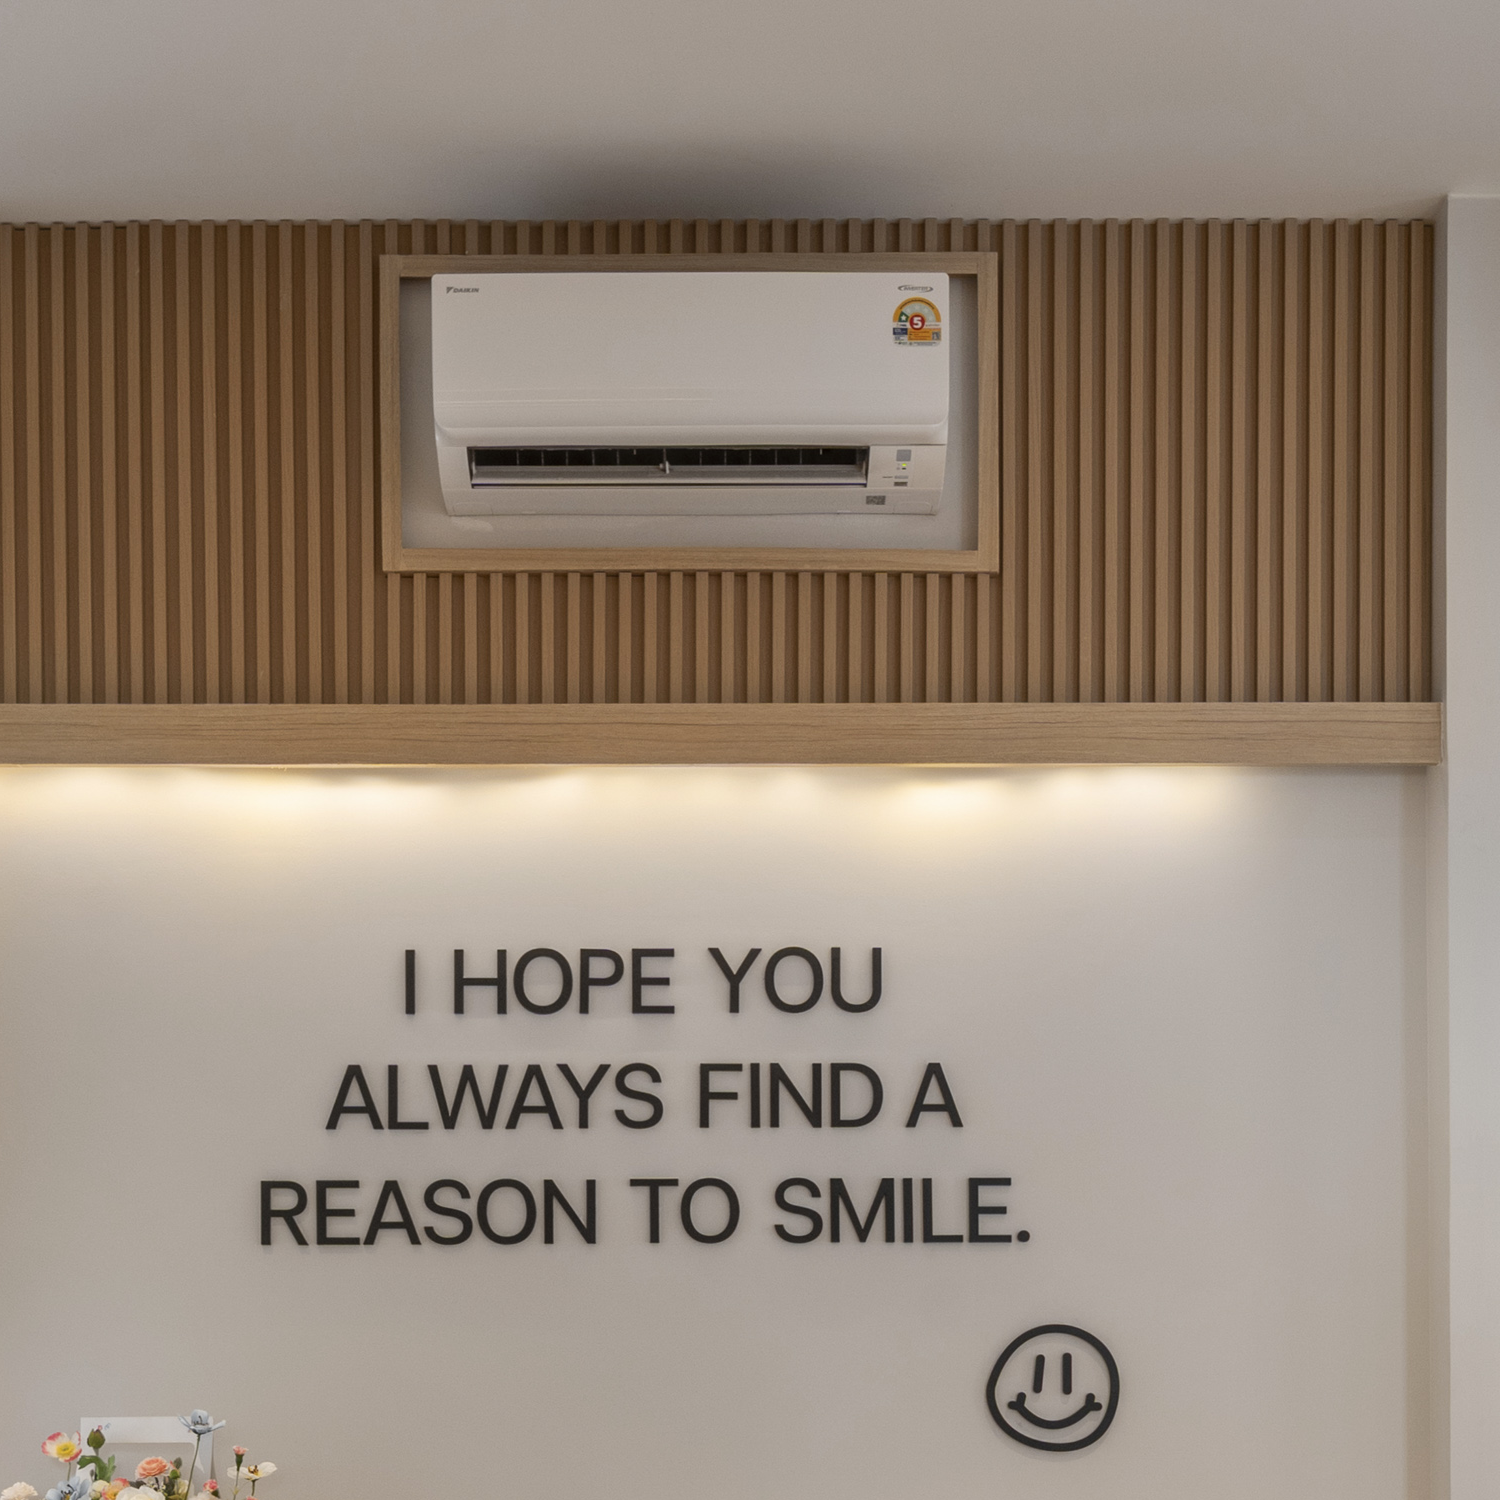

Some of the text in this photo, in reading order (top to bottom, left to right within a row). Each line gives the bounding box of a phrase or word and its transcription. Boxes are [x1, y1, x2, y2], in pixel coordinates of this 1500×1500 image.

[913, 317, 923, 329] 5
[404, 946, 883, 1016] I HOPE YOU
[325, 1062, 964, 1131] ALWAYS FIND A
[260, 1177, 1031, 1247] REASON TO SMILE.
